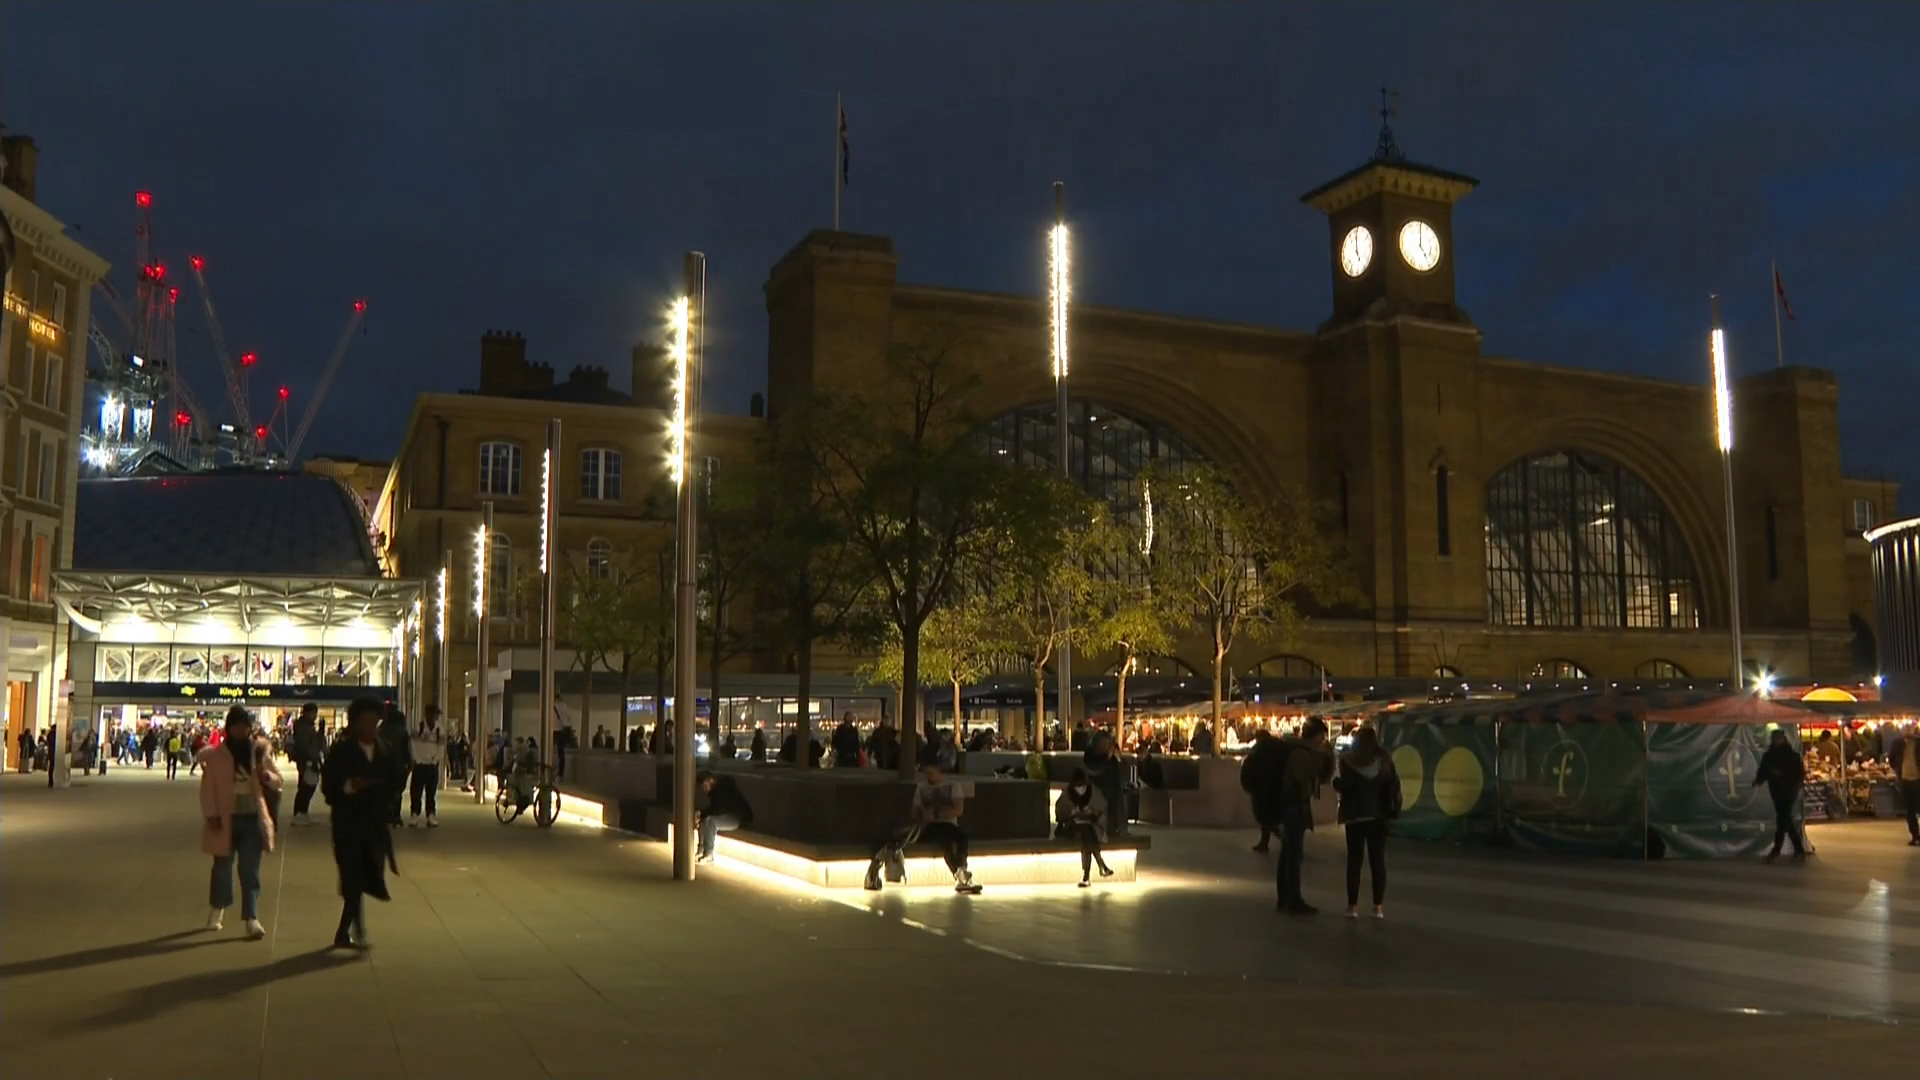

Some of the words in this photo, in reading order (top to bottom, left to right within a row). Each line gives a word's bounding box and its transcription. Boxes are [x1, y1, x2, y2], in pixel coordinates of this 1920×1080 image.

[28, 317, 56, 341] HOTEL
[219, 686, 243, 697] King's
[248, 687, 271, 696] Cross
